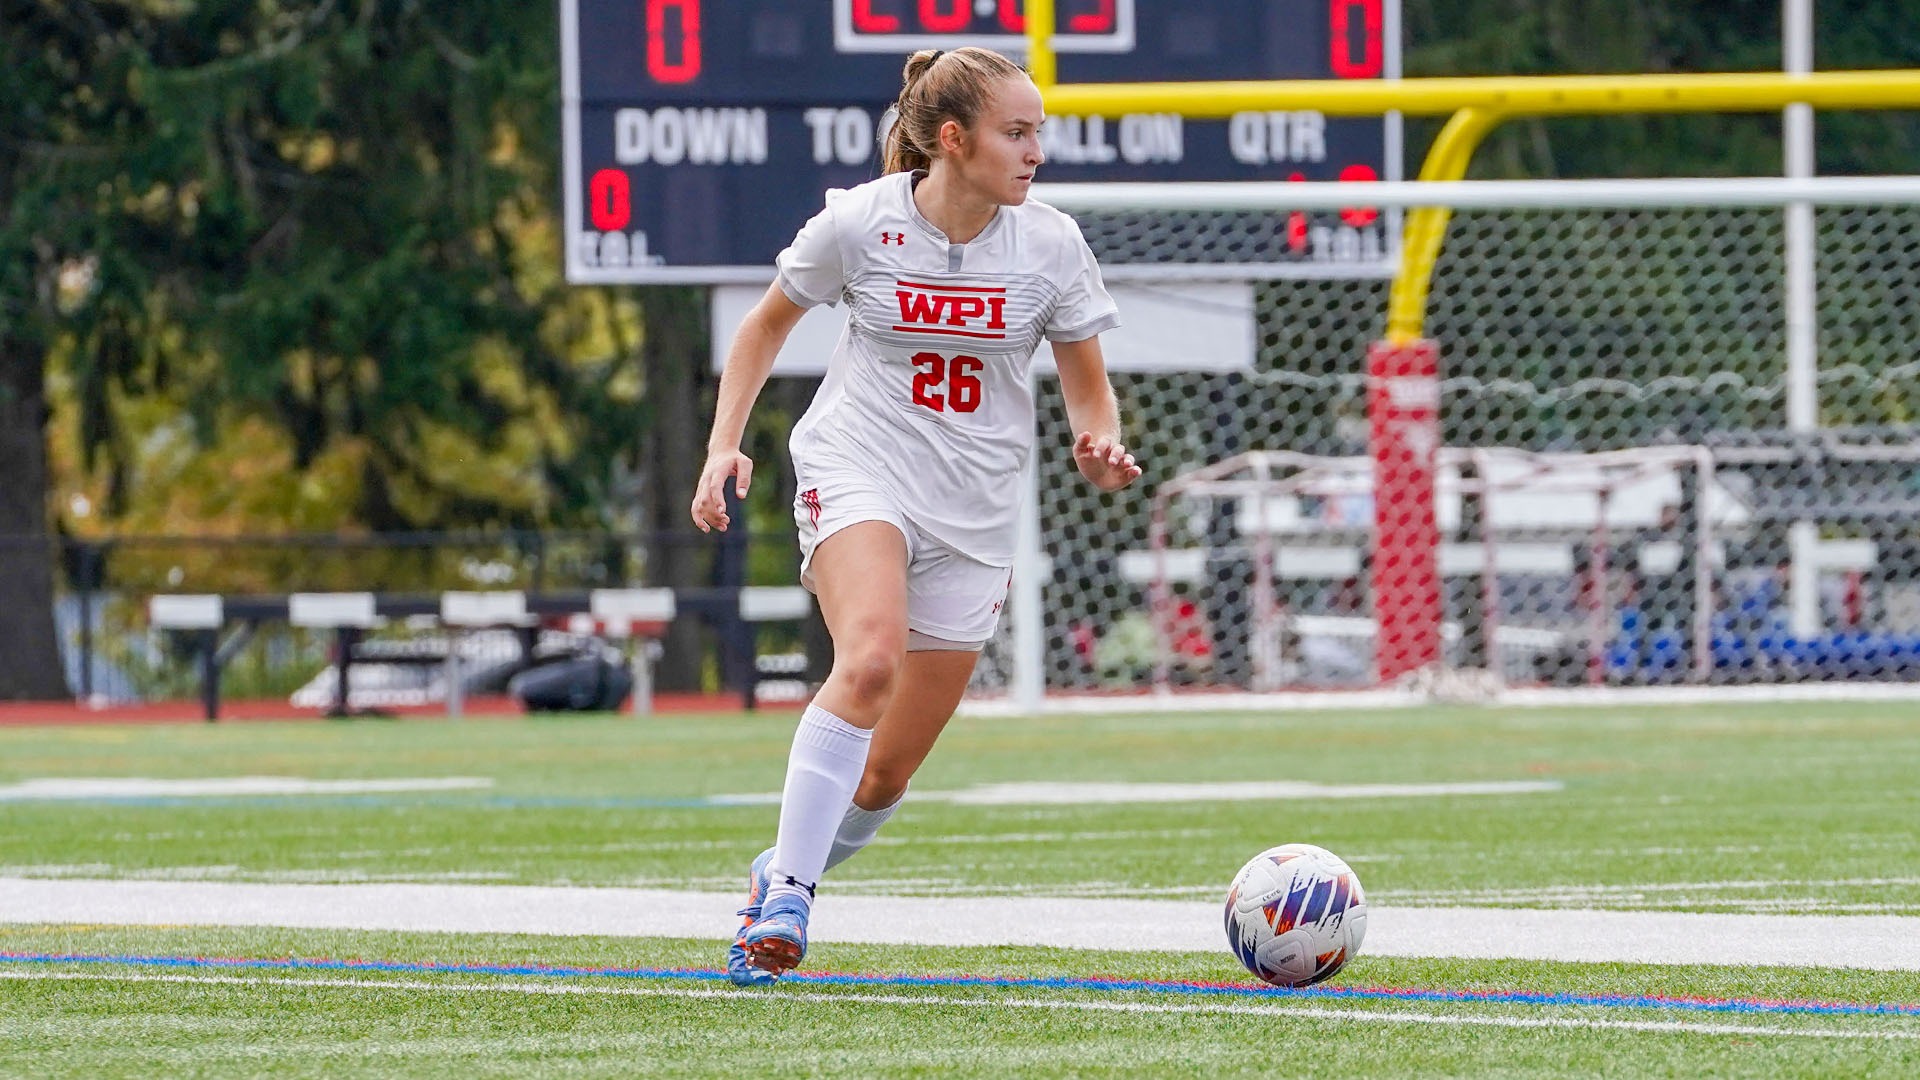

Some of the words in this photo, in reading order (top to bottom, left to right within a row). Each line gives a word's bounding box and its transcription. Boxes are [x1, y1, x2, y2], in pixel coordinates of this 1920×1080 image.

[646, 0, 701, 83] 0
[1330, 0, 1382, 78] 0
[614, 106, 768, 165] DOWN
[804, 105, 872, 165] TO
[1042, 114, 1118, 163] ALL
[1118, 112, 1184, 164] ON
[1229, 110, 1327, 165] QTR
[590, 168, 630, 231] 0
[896, 290, 1006, 330] WPI
[911, 352, 984, 413] 26
